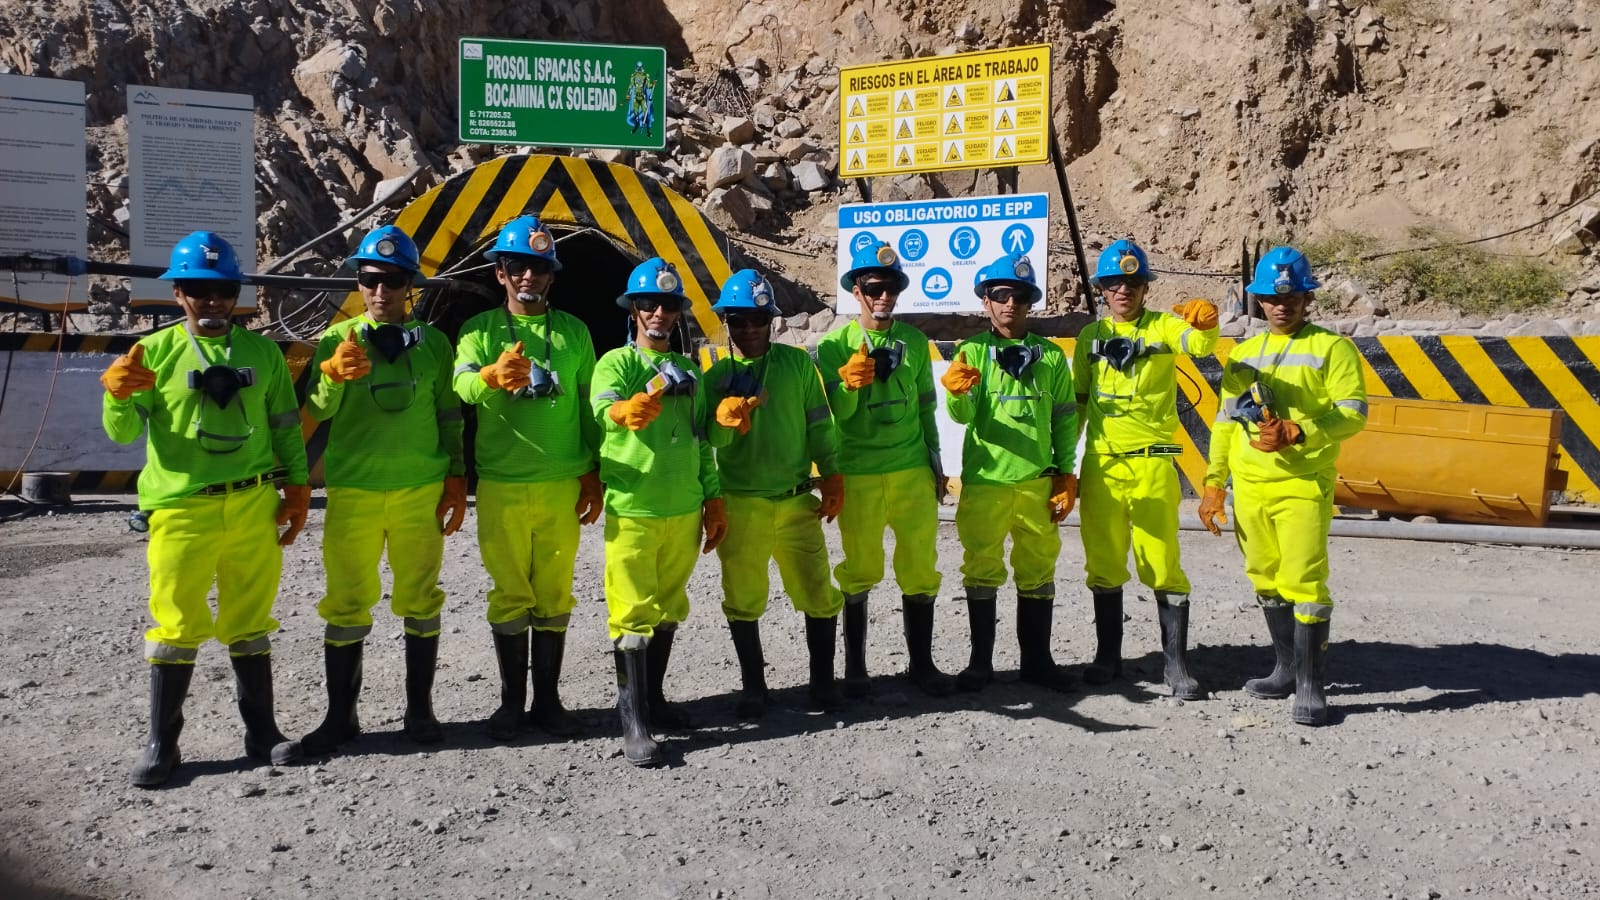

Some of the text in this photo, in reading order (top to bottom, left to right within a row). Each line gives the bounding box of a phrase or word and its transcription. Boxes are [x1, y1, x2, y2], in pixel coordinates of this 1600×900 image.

[486, 54, 616, 84] PROSOL ISPACAS S.A.C.
[849, 56, 1039, 92] RIESGOS EN EL ÁREA DE TRABAJO
[485, 82, 617, 111] BOCAMINA CX SOLEDAD
[469, 128, 490, 136] COTA:
[853, 201, 1033, 224] USO OBLIGATORIO DE EPP
